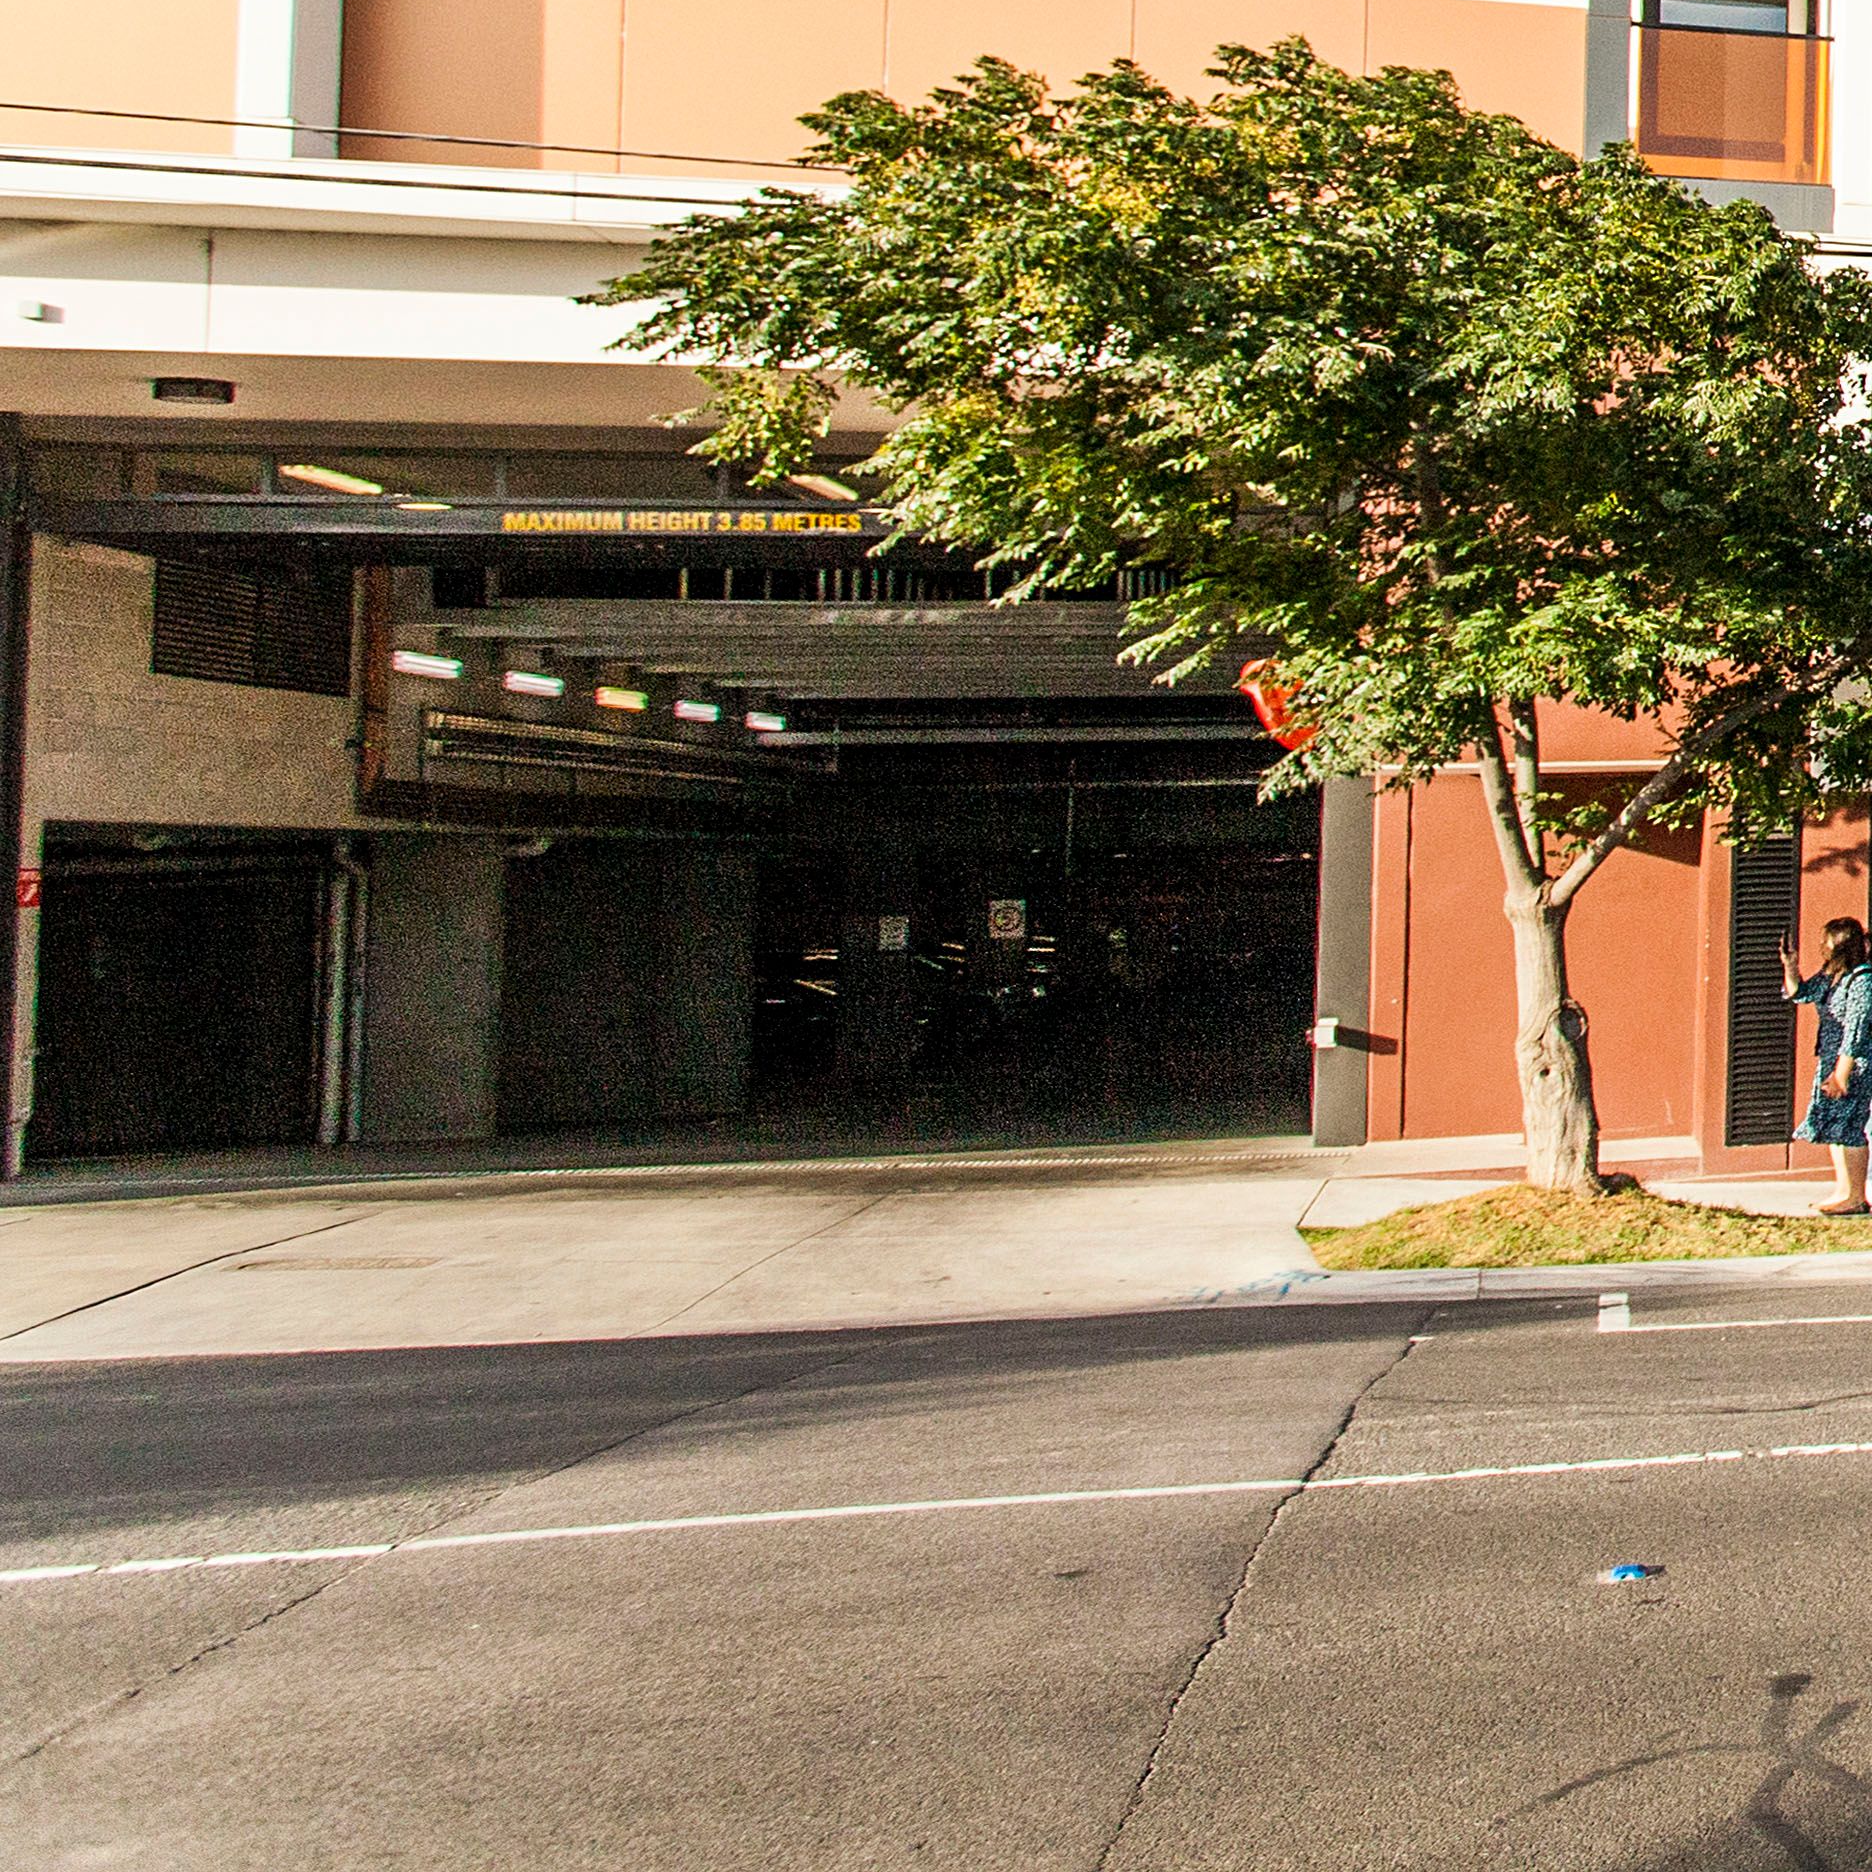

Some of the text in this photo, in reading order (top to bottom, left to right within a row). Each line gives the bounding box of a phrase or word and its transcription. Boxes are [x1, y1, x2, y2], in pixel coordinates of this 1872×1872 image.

[503, 512, 861, 532] MAXIMUM HEIGHT 3.85 METRES
